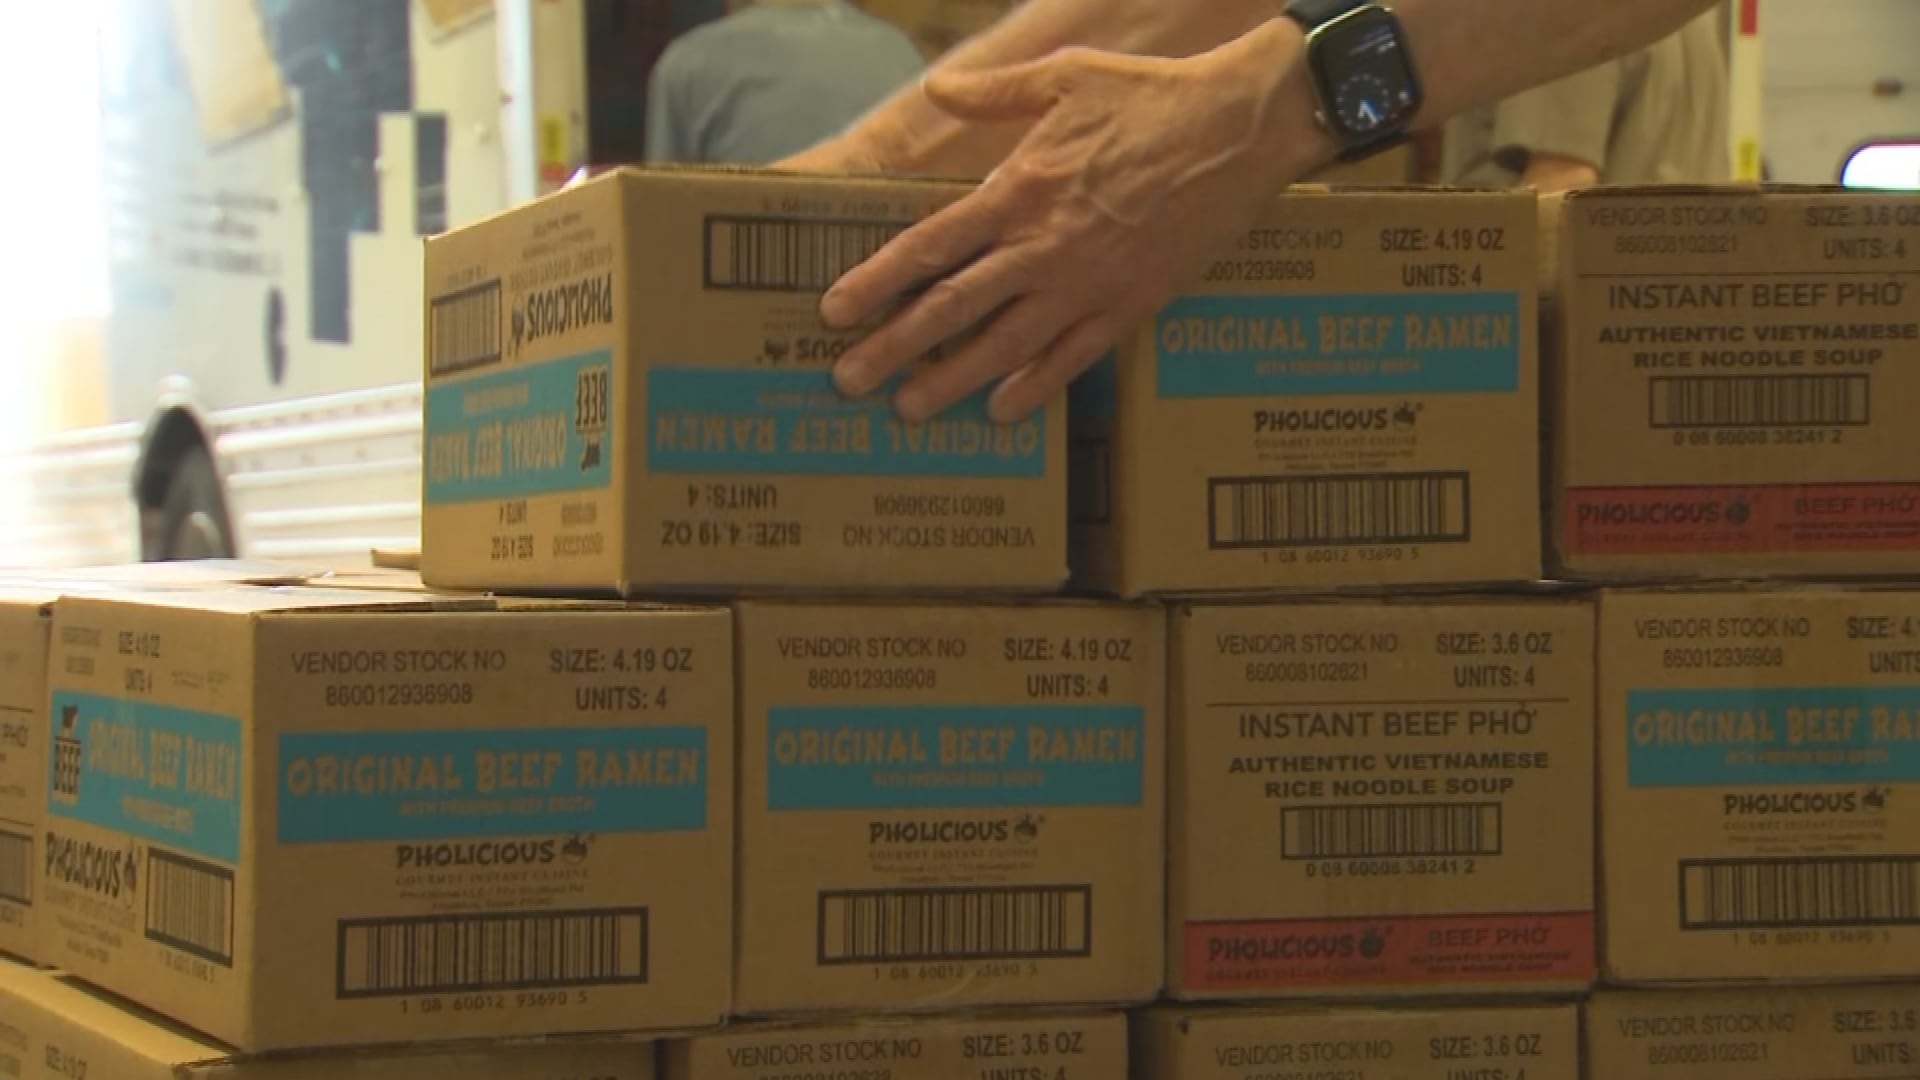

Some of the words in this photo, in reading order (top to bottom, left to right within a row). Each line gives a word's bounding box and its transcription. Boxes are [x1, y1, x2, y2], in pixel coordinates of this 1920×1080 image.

[1585, 206, 1664, 227] VENDOR
[1671, 206, 1736, 226] STOCK
[1740, 205, 1767, 225] NO
[1805, 206, 1857, 227] SIZE:
[1248, 229, 1310, 250] STOCK
[1316, 229, 1343, 250] NO
[1380, 228, 1429, 252] SIZE:
[1434, 229, 1471, 251] 4.19
[1480, 229, 1505, 250] OZ
[1824, 238, 1888, 259] UNITS:
[1893, 238, 1905, 259] 4
[1402, 263, 1467, 288] UNITS:
[1470, 264, 1483, 287] 4
[527, 272, 613, 342] PHOLICIOUS
[1608, 284, 1743, 309] INSTANT
[1752, 283, 1827, 307] BEEF
[1162, 316, 1308, 354] ORIGINAL
[1319, 315, 1393, 354] BEEF
[1405, 314, 1512, 352] RAMEN
[1598, 326, 1745, 344] AUTHENTIC
[1752, 324, 1918, 342] VIETNAMESE
[1632, 351, 1693, 368] RICE
[1701, 350, 1804, 367] NOODLE
[1813, 349, 1883, 366] SOUP
[576, 371, 608, 425] BEEF
[1253, 407, 1388, 432] PHOLICIOUS
[656, 415, 777, 454] RAMEN
[788, 415, 870, 456] BEEF
[883, 419, 1039, 457] ORIGINAL
[686, 485, 699, 509] 4
[706, 484, 777, 509] UNITS:
[1794, 498, 1856, 515] BEEF
[1577, 502, 1721, 527] PHOLICIOUS
[662, 521, 693, 547] OZ
[699, 521, 742, 547] 4.19
[748, 521, 801, 546] SIZE:
[842, 526, 872, 547] NO
[878, 526, 945, 548] STOCK
[952, 526, 1035, 548] VENDOR
[1634, 618, 1712, 640] VENDOR
[1719, 617, 1780, 639] STOCK
[1783, 617, 1810, 638] NO
[1847, 616, 1897, 640] SIZE:
[777, 637, 861, 659] VENDOR
[867, 637, 931, 658] STOCK
[937, 636, 967, 658] NO
[1003, 637, 1055, 661] SIZE:
[1060, 638, 1099, 661] 4.19
[1104, 638, 1132, 661] OZ
[1216, 632, 1297, 655] VENDOR
[1301, 632, 1367, 654] STOCK
[1371, 632, 1399, 653] NO
[1435, 632, 1486, 655] SIZE:
[1492, 632, 1519, 654] 3.6
[1524, 632, 1553, 654] OZ
[290, 650, 387, 675] VENDOR
[393, 649, 467, 673] STOCK
[473, 648, 507, 672] NO
[549, 648, 607, 674] SIZE:
[611, 647, 656, 672] 4.19
[662, 647, 694, 672] OZ
[1026, 674, 1092, 698] UNITS:
[1097, 674, 1110, 698] 4
[1454, 665, 1519, 688] UNITS:
[1523, 665, 1536, 687] 4
[325, 682, 473, 708] 860012936908
[575, 685, 649, 711] UNITS:
[654, 685, 668, 710] 4
[1240, 711, 1375, 739] INSTANT
[1383, 710, 1459, 737] BEEF
[1633, 708, 1779, 746] ORIGINAL
[1786, 706, 1858, 746] BEEF
[775, 728, 928, 766] ORIGINAL
[939, 727, 1016, 766] BEEF
[1028, 725, 1138, 764] RAMEN
[53, 742, 81, 796] BEEF
[286, 754, 463, 796] ORIGINAL
[474, 748, 563, 794] BEEF
[575, 745, 700, 790] RAMEN
[1228, 755, 1376, 774] AUTHENTIC
[1384, 752, 1549, 770] VIETNAMESE
[1264, 780, 1324, 798] RICE
[1333, 778, 1437, 797] NOODLE
[1445, 776, 1515, 795] SOUP
[1723, 791, 1857, 816] PHOLICIOUS
[869, 820, 1009, 845] PHOLICIOUS
[46, 832, 120, 899] PHOLICIOUS
[395, 840, 556, 870] PHOLICIOUS
[1465, 859, 1476, 875] 2
[1208, 934, 1354, 961] PHOLICIOUS
[1428, 927, 1489, 946] BEEF
[1617, 1016, 1697, 1038] VENDOR
[1702, 1013, 1763, 1035] STOCK
[1768, 1012, 1795, 1032] NO
[1833, 1010, 1884, 1033] SIZE:
[727, 1043, 815, 1068] VENDOR
[820, 1040, 888, 1063] STOCK
[892, 1037, 922, 1058] NO
[963, 1035, 1015, 1058] SIZE:
[1022, 1033, 1049, 1056] 3.6
[1055, 1032, 1084, 1054] OZ
[1216, 1045, 1294, 1068] VENDOR
[1300, 1042, 1361, 1063] STOCK
[1366, 1039, 1393, 1060] NO
[1430, 1037, 1477, 1060] SIZE:
[1484, 1035, 1510, 1058] 3.6
[1516, 1033, 1543, 1056] OZ
